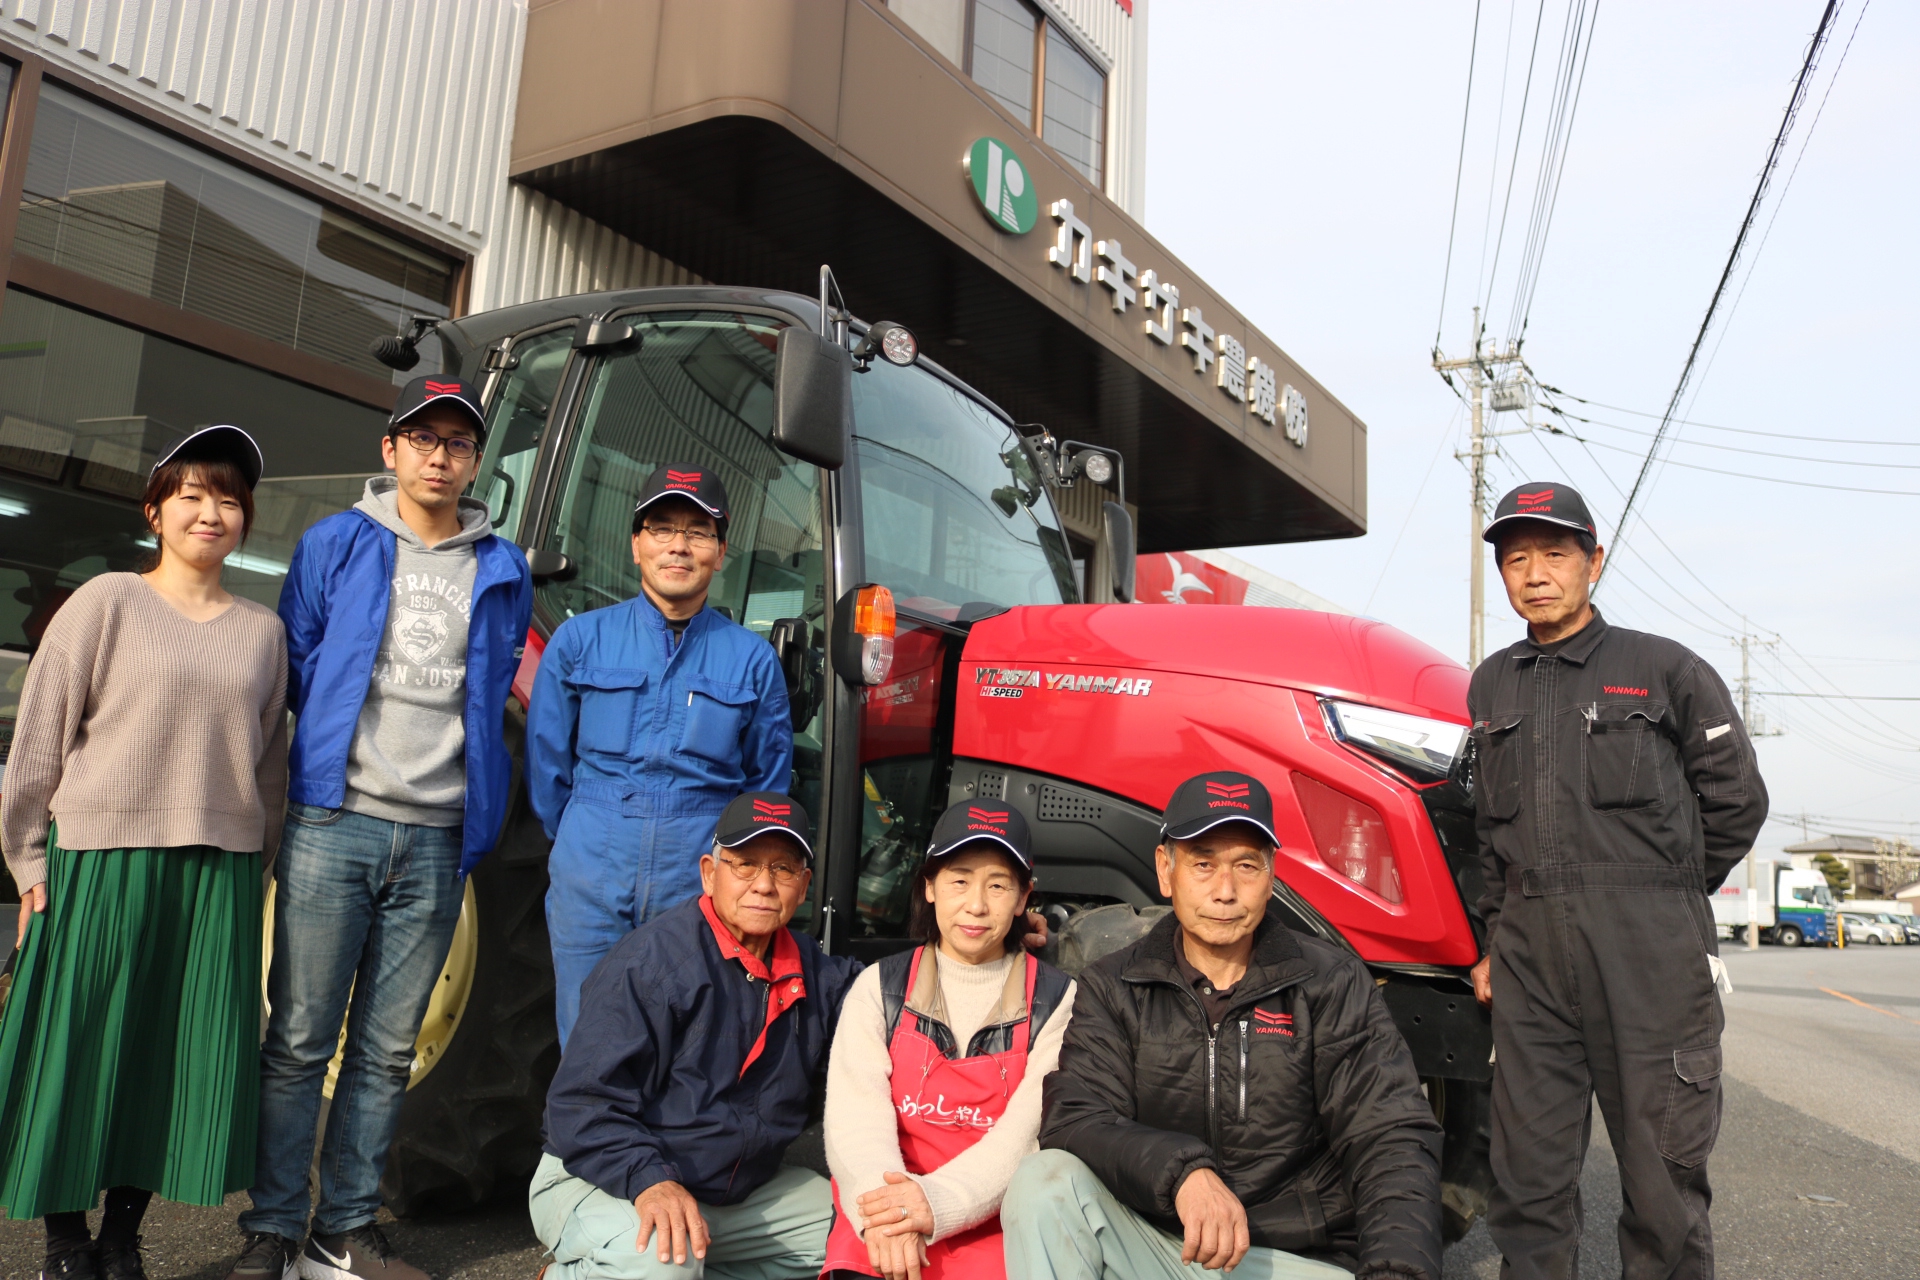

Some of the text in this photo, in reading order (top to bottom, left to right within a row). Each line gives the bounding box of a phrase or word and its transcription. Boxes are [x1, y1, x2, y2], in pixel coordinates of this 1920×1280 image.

[664, 483, 699, 493] YANMAR
[1515, 505, 1552, 515] YANMAR
[1045, 673, 1152, 697] YANMAR
[1603, 685, 1649, 697] YANMAR
[1207, 800, 1250, 811] YANMAR
[752, 815, 789, 827] YANMAR
[967, 823, 1006, 836] YANMAR
[1255, 1027, 1293, 1037] YANMAR
